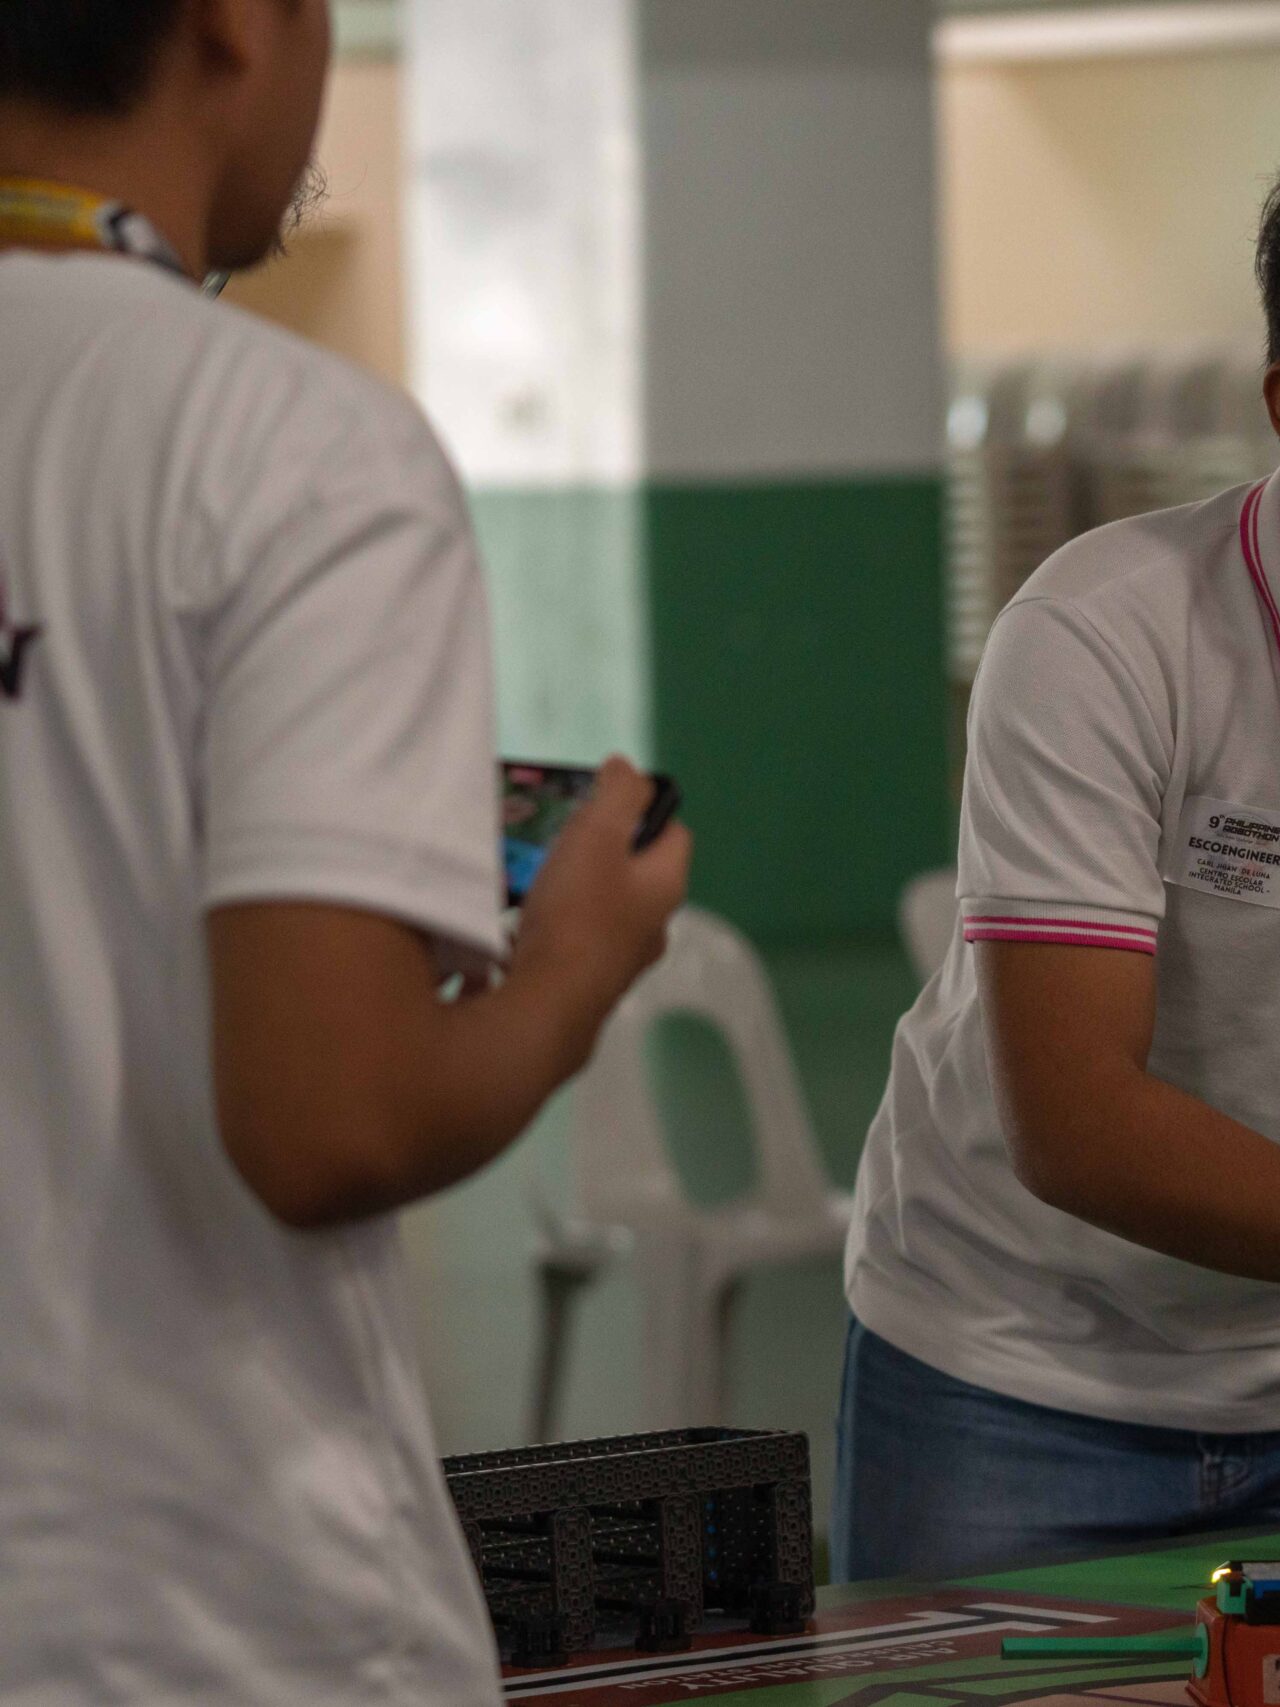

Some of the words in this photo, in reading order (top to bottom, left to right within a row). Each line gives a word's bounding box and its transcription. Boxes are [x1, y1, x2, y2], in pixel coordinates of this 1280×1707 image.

[1223, 825, 1280, 842] ROBOTHON
[1197, 858, 1214, 868] CARL
[1189, 871, 1232, 886] INTEGRATED
[1234, 881, 1264, 893] SCHOOL
[1200, 867, 1228, 879] CENTRO
[1231, 874, 1263, 886] ESCOLAR
[1214, 884, 1241, 895] MANILA
